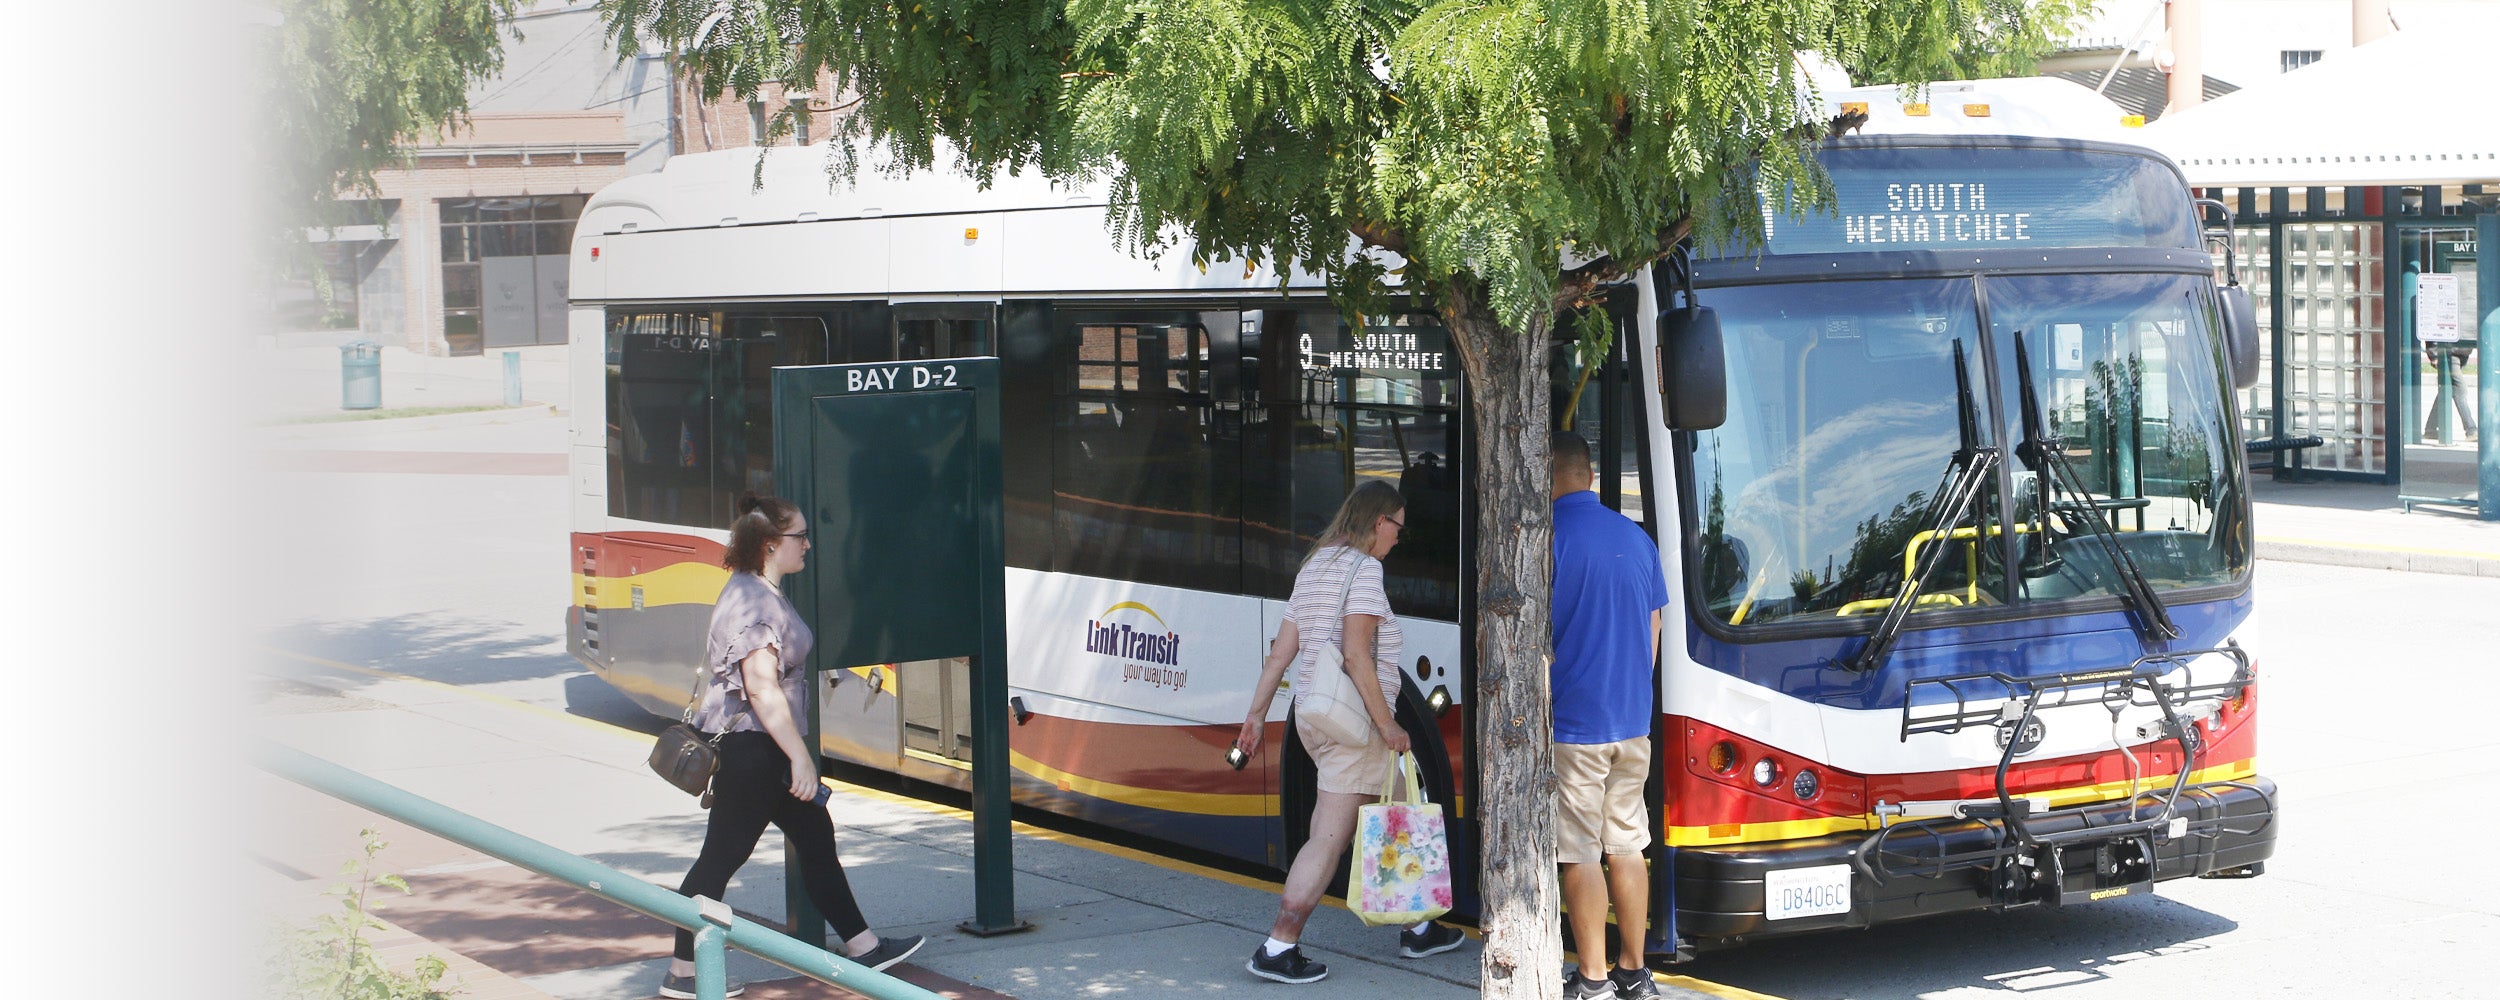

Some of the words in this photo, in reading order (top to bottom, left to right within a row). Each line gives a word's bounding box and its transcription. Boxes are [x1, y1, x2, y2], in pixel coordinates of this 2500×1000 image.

[1887, 183, 1985, 211] SOUTH
[1846, 213, 2031, 243] WENATCHEE
[2453, 243, 2471, 252] BAY
[1299, 333, 1313, 370] 9
[1353, 333, 1416, 351] SOUTH
[1329, 351, 1443, 370] WENATCHEE
[847, 367, 900, 392] BAY
[912, 365, 958, 389] D-2
[1086, 619, 1119, 656] Link
[1121, 624, 1180, 666] Transit
[1123, 663, 1143, 683] your
[1144, 667, 1161, 688] way
[1163, 665, 1173, 686] to
[1173, 669, 1188, 691] go!
[1783, 883, 1845, 911] D8406C
[2090, 887, 2128, 901] sportworks
